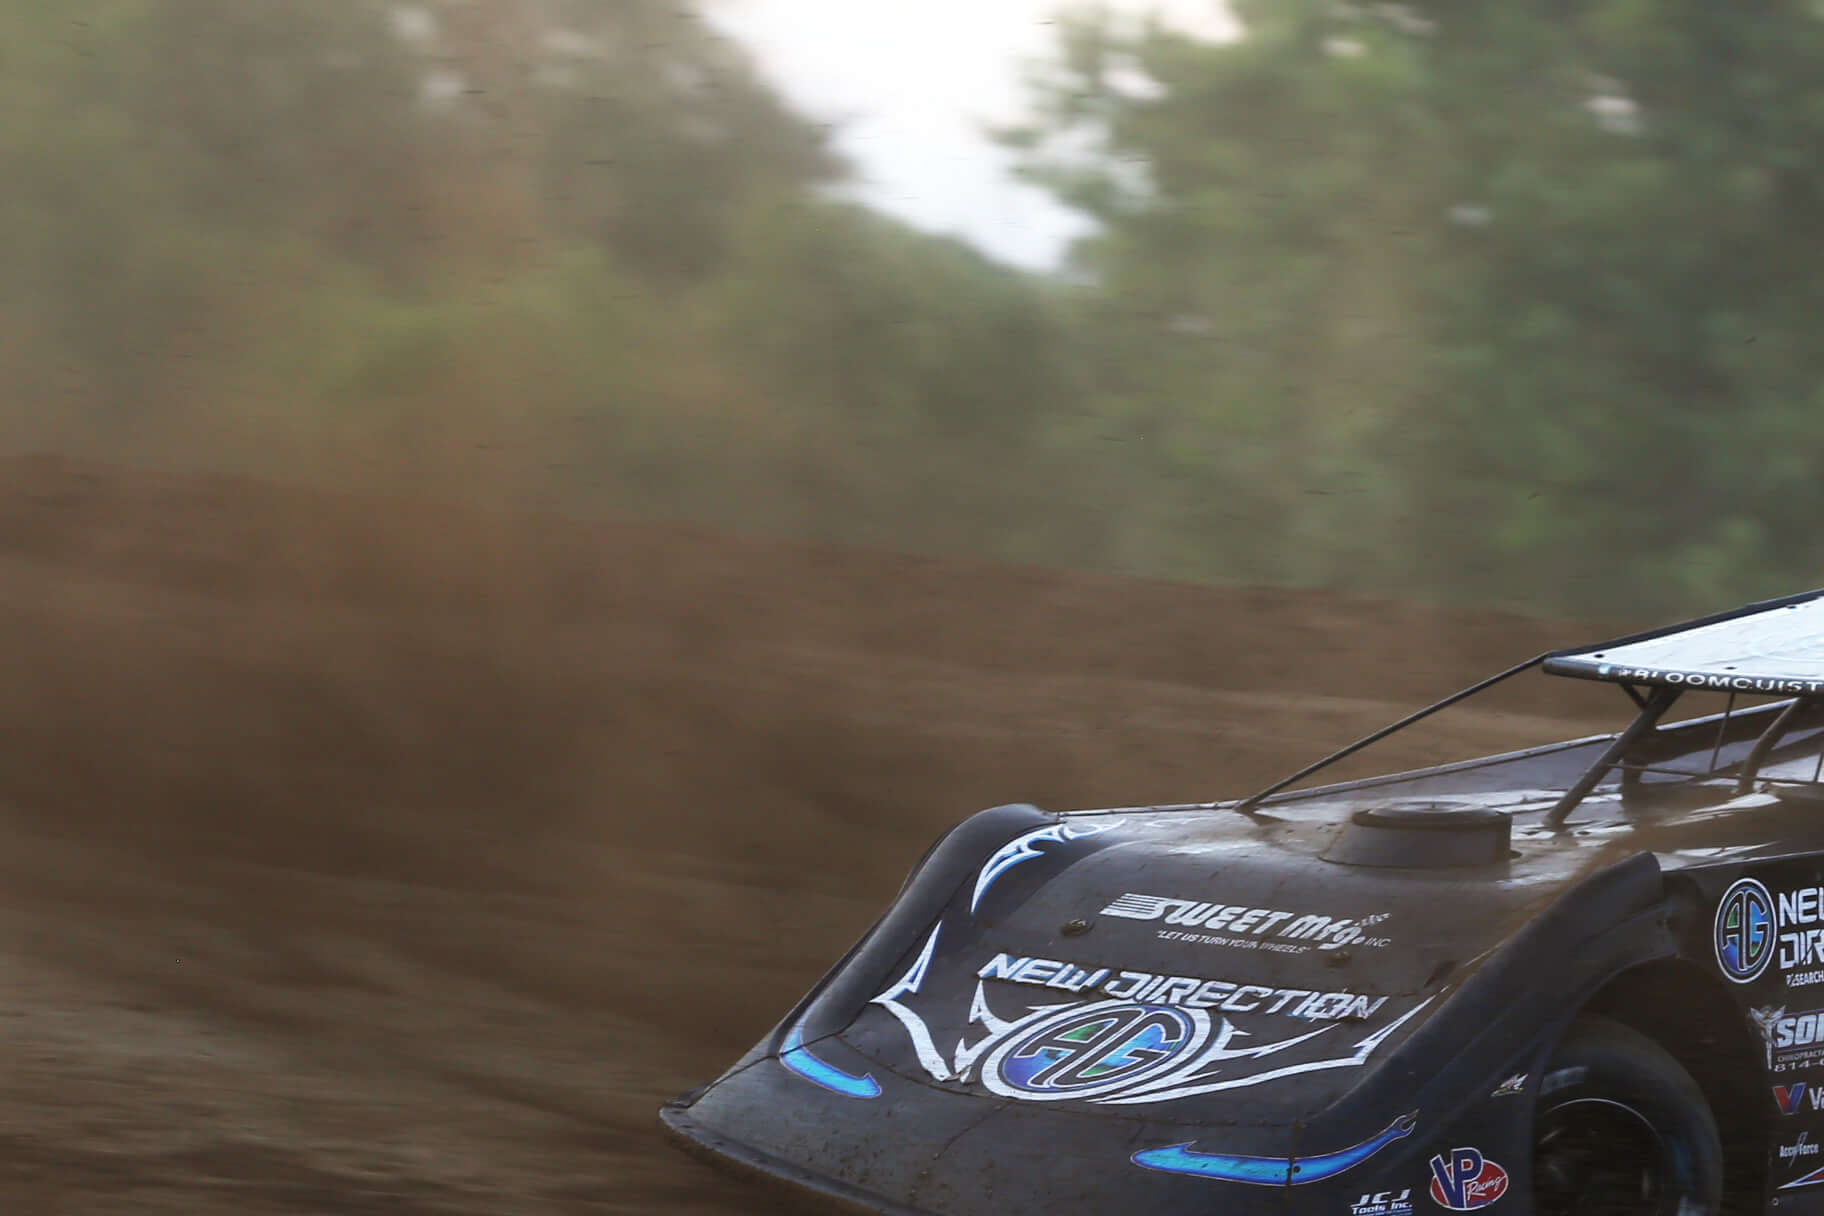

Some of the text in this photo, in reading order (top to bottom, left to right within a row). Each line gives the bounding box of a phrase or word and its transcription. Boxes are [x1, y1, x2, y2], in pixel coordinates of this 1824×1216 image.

[1099, 893, 1294, 934] SWEET
[1181, 933, 1199, 942] US
[1199, 935, 1229, 945] TURN
[1228, 939, 1258, 949] YOUR
[976, 953, 1391, 1022] NEW DIRECTION
[1430, 1147, 1483, 1209] VP
[1466, 1174, 1508, 1200] Racing
[1352, 1202, 1413, 1215] Tools Inc.
